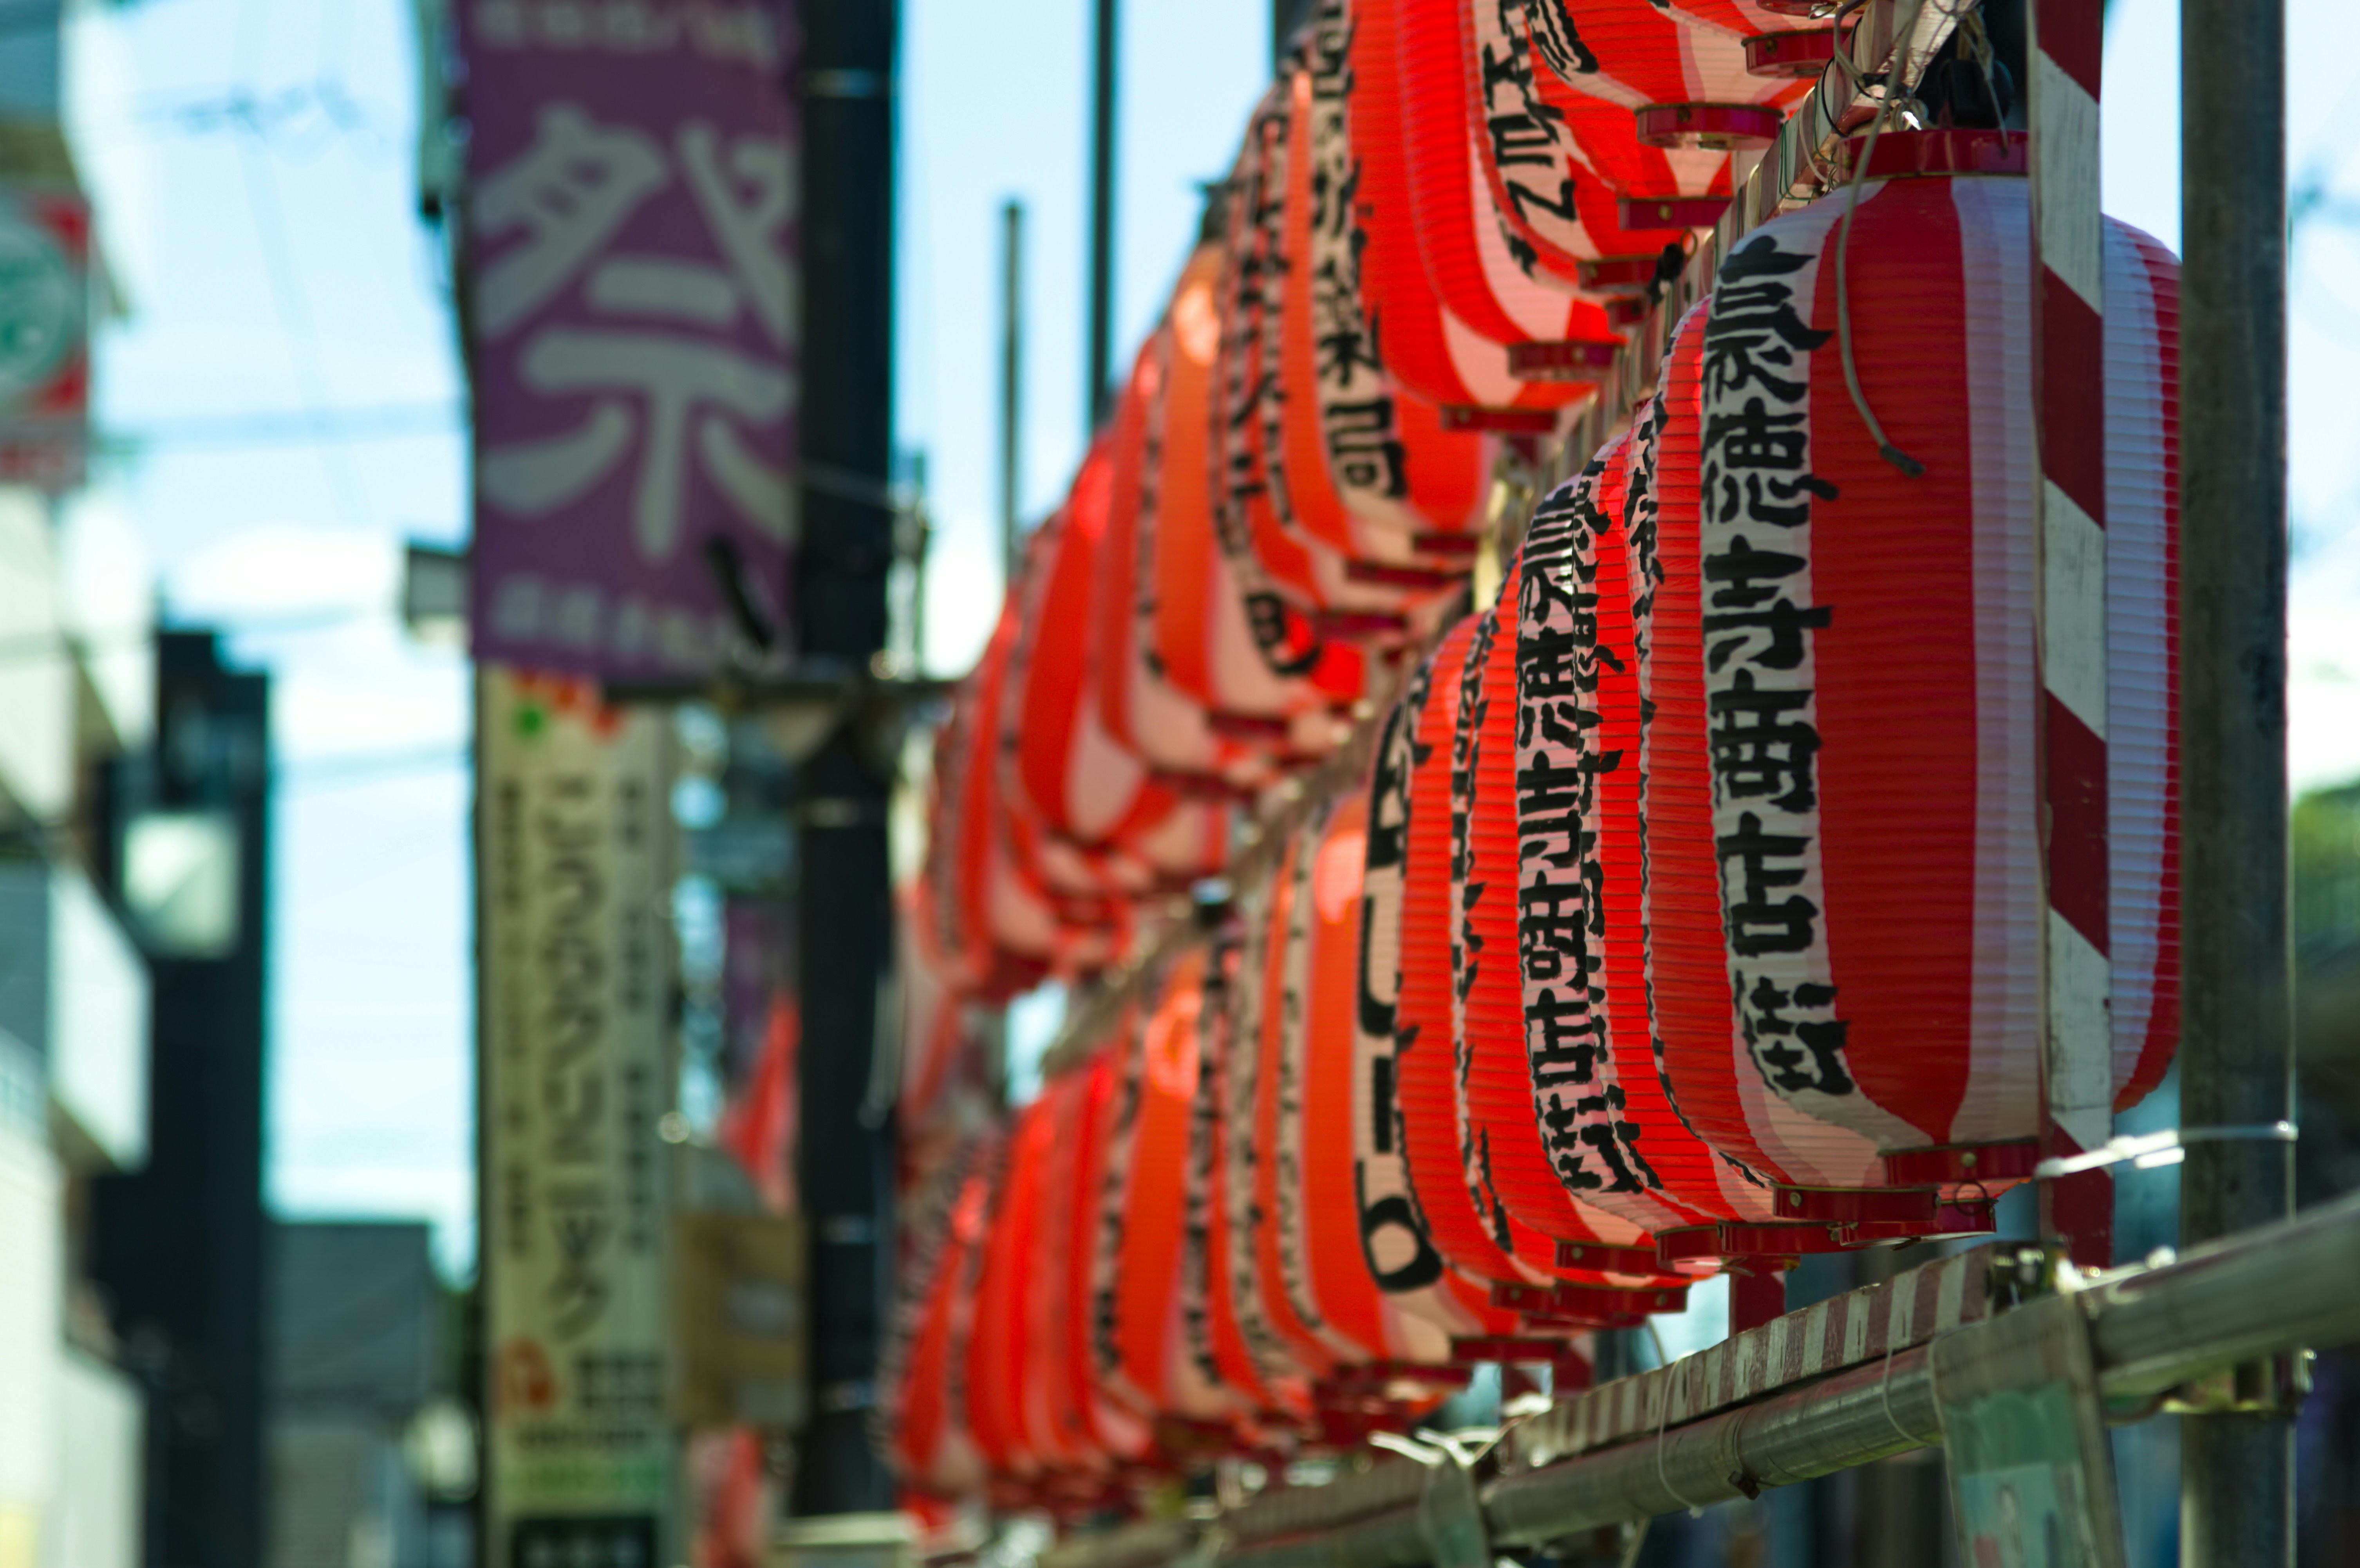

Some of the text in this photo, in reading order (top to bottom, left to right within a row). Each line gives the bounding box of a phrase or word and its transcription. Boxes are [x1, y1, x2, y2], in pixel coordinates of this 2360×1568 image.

[1702, 236, 1853, 1095] 豪徳寺商店街
